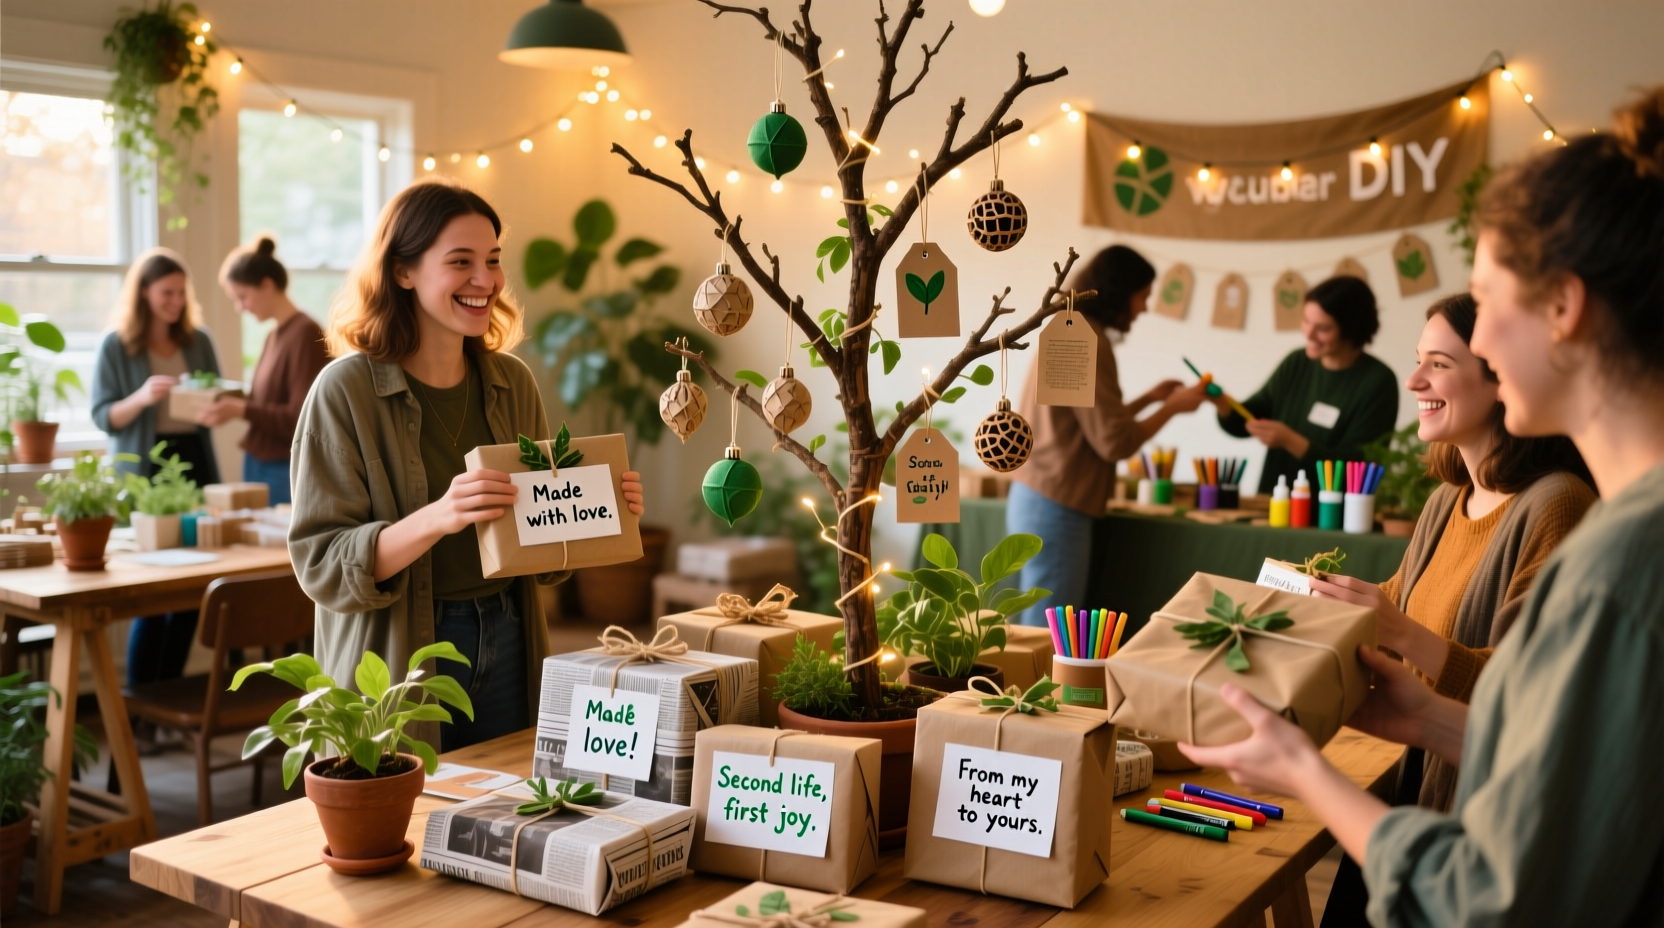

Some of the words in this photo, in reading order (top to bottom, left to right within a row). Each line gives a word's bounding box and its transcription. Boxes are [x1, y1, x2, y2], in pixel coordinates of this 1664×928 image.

[1349, 137, 1449, 201] DIY
[533, 481, 583, 503] Made
[526, 506, 567, 527] with
[572, 504, 612, 523] love.
[584, 726, 638, 760] love!
[717, 765, 783, 794] Second
[791, 772, 827, 803] life,
[959, 758, 1004, 785] From
[1011, 775, 1039, 797] my
[970, 784, 1023, 810] heart
[723, 796, 769, 824] first
[774, 804, 816, 838] joy.
[957, 804, 978, 823] to
[985, 813, 1042, 835] yours.
